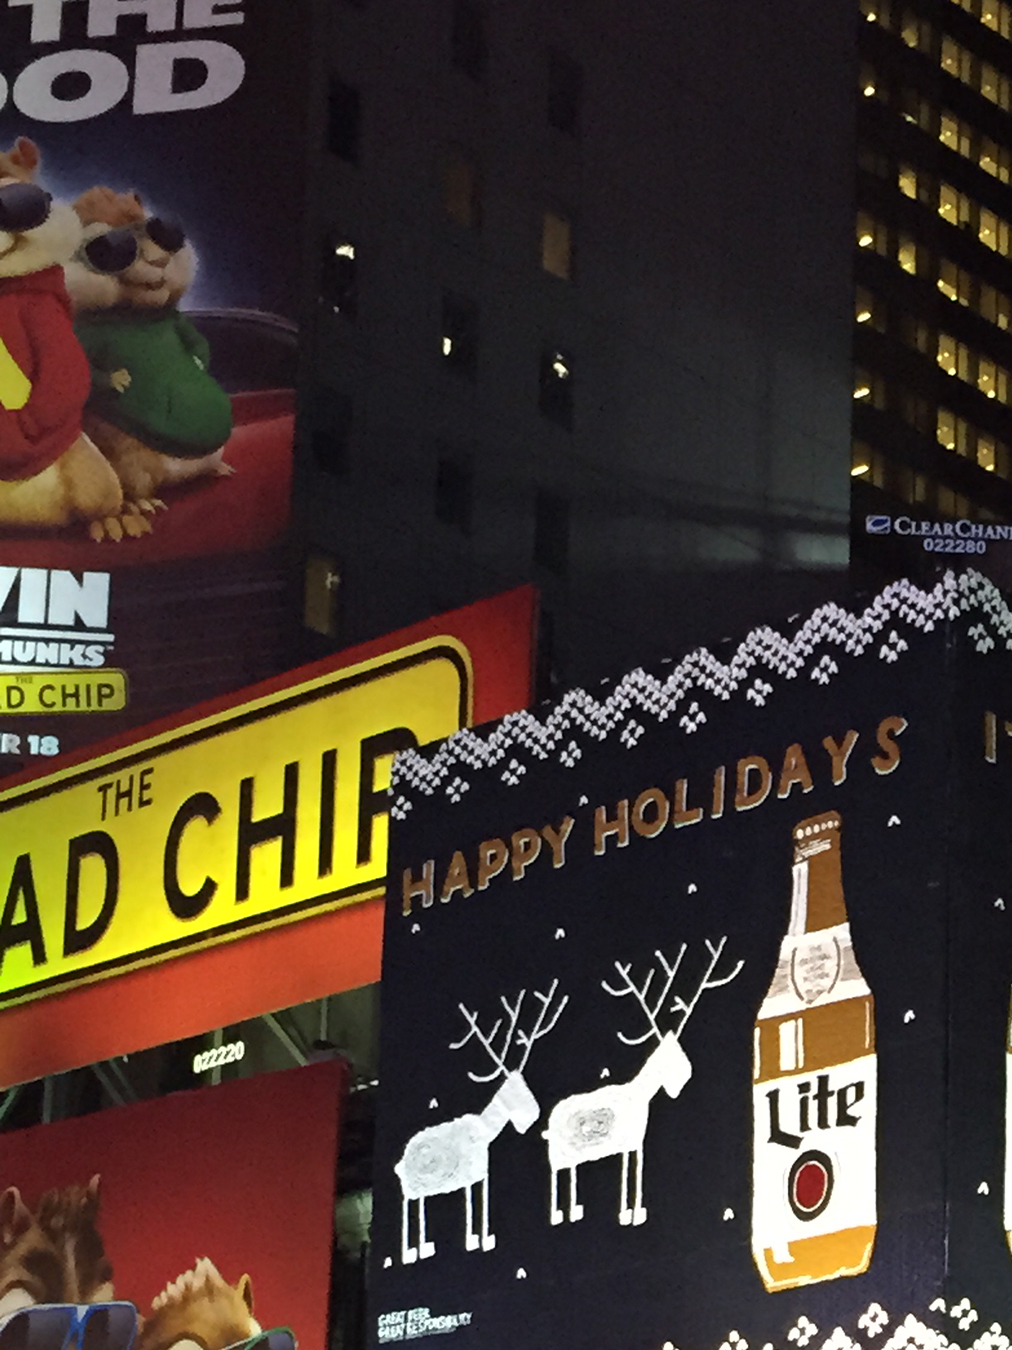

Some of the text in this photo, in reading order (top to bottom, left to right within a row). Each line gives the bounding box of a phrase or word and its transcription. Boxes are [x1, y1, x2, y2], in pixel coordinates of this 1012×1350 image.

[0, 40, 247, 123] OD
[923, 538, 987, 554] 022280
[37, 683, 116, 710] CHIP
[27, 734, 60, 757] 18
[97, 766, 155, 821] THE
[401, 715, 908, 916] HAPPY HOLIDAYS
[163, 727, 420, 923] CHIP
[192, 1041, 245, 1074] 022220
[764, 1074, 866, 1150] Lite
